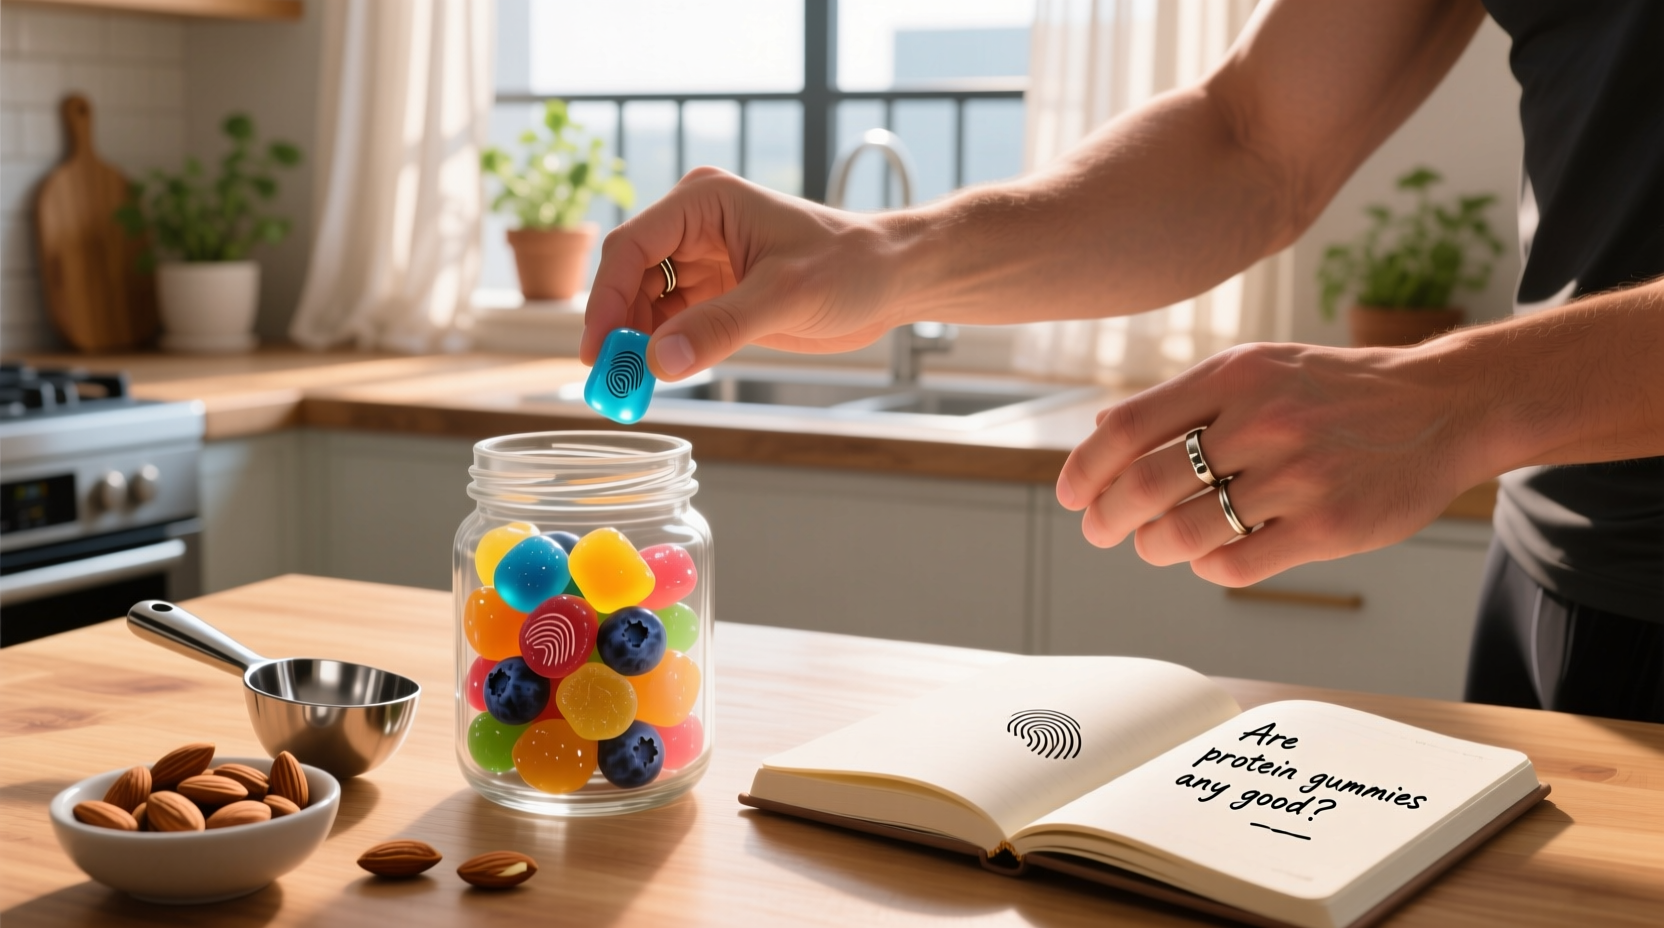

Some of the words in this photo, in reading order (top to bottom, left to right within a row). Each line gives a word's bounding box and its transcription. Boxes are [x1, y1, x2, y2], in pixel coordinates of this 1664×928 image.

[1238, 722, 1299, 750] Are
[1175, 774, 1231, 802] any
[1229, 789, 1337, 822] good?
[1191, 747, 1298, 780] protein
[1298, 773, 1428, 810] gummies
